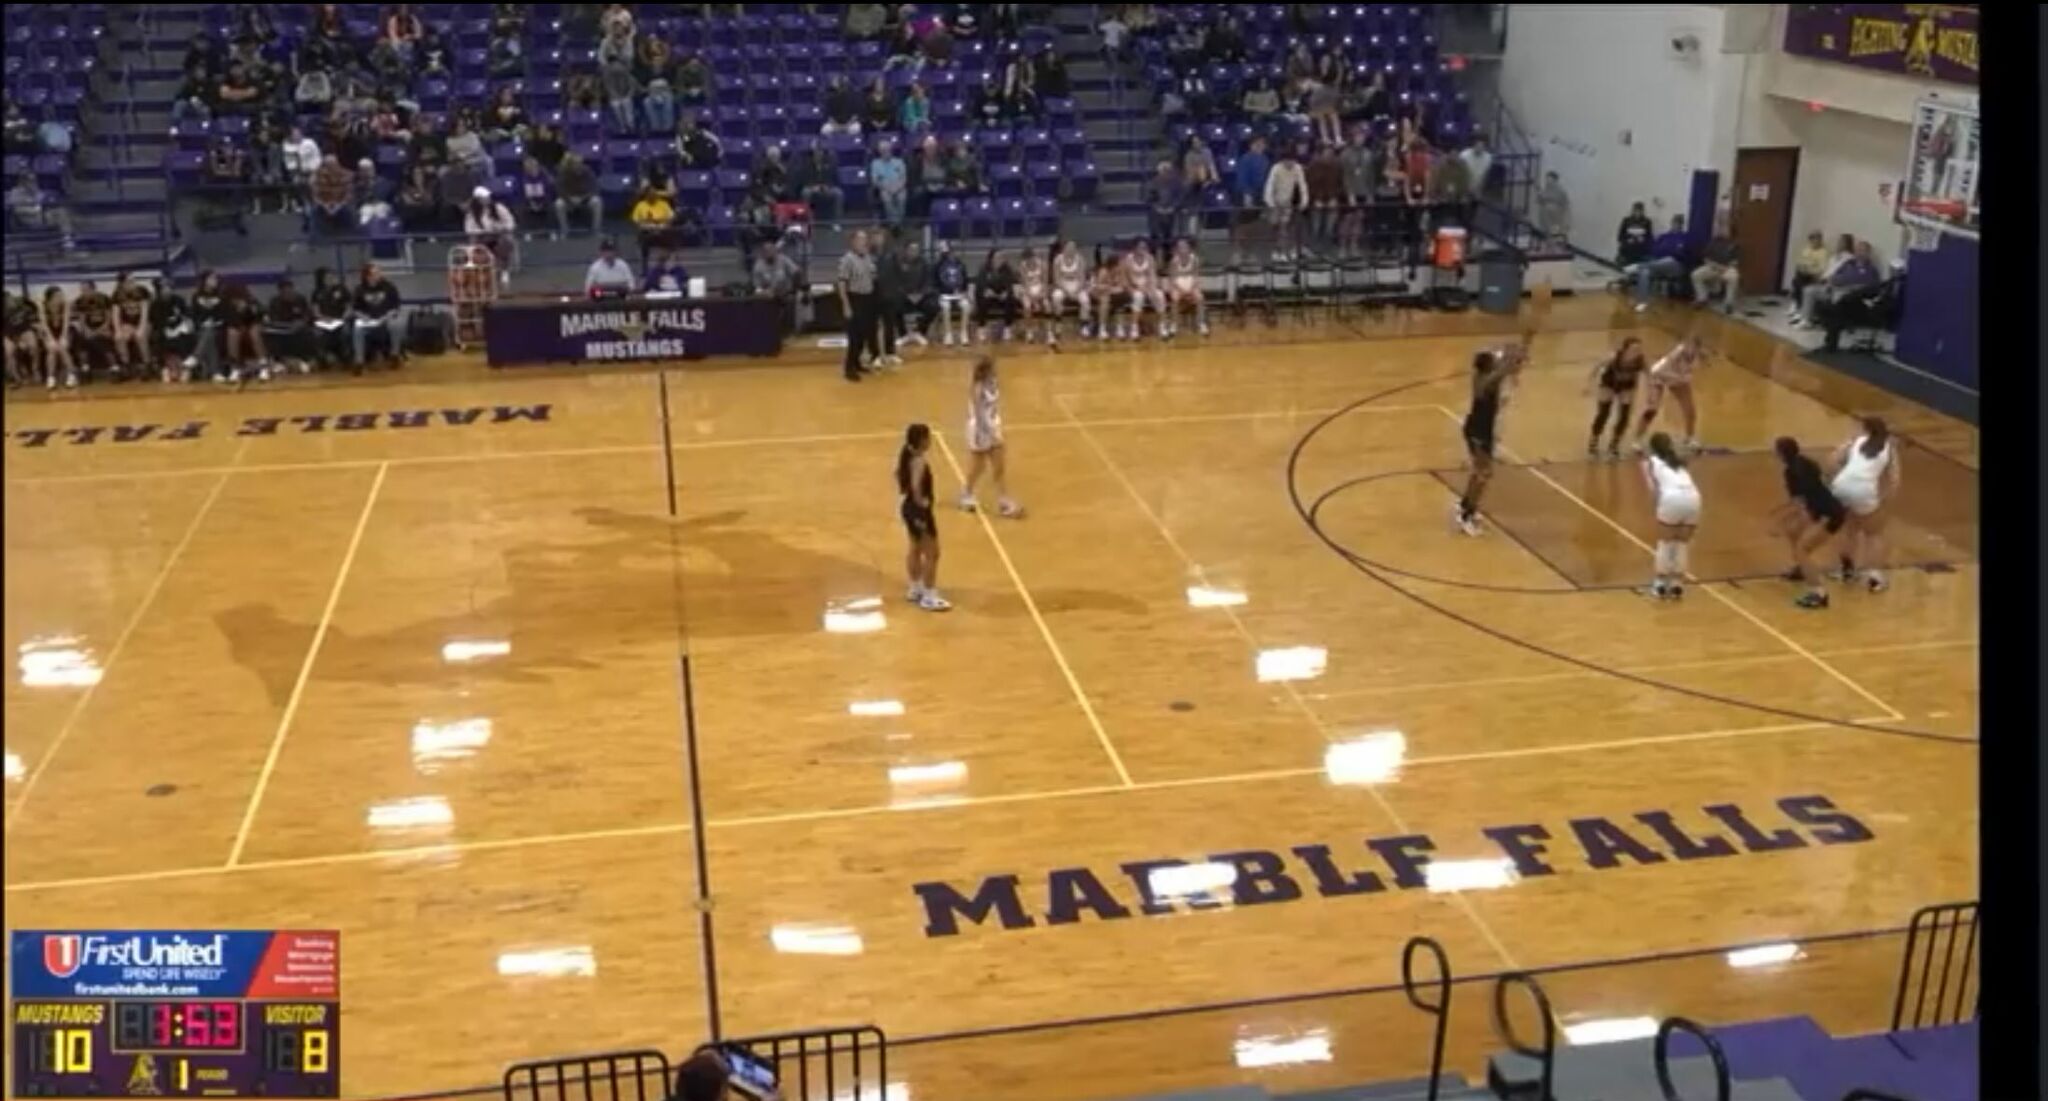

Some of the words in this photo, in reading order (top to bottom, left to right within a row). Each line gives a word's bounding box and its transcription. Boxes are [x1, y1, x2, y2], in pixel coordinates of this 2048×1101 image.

[560, 310, 642, 337] MARBLE
[650, 308, 705, 331] FALLS
[585, 338, 685, 359] MUSTANGS
[237, 402, 553, 437] MARBLE
[5, 420, 207, 449] FALL
[1483, 795, 1875, 877] FALLS
